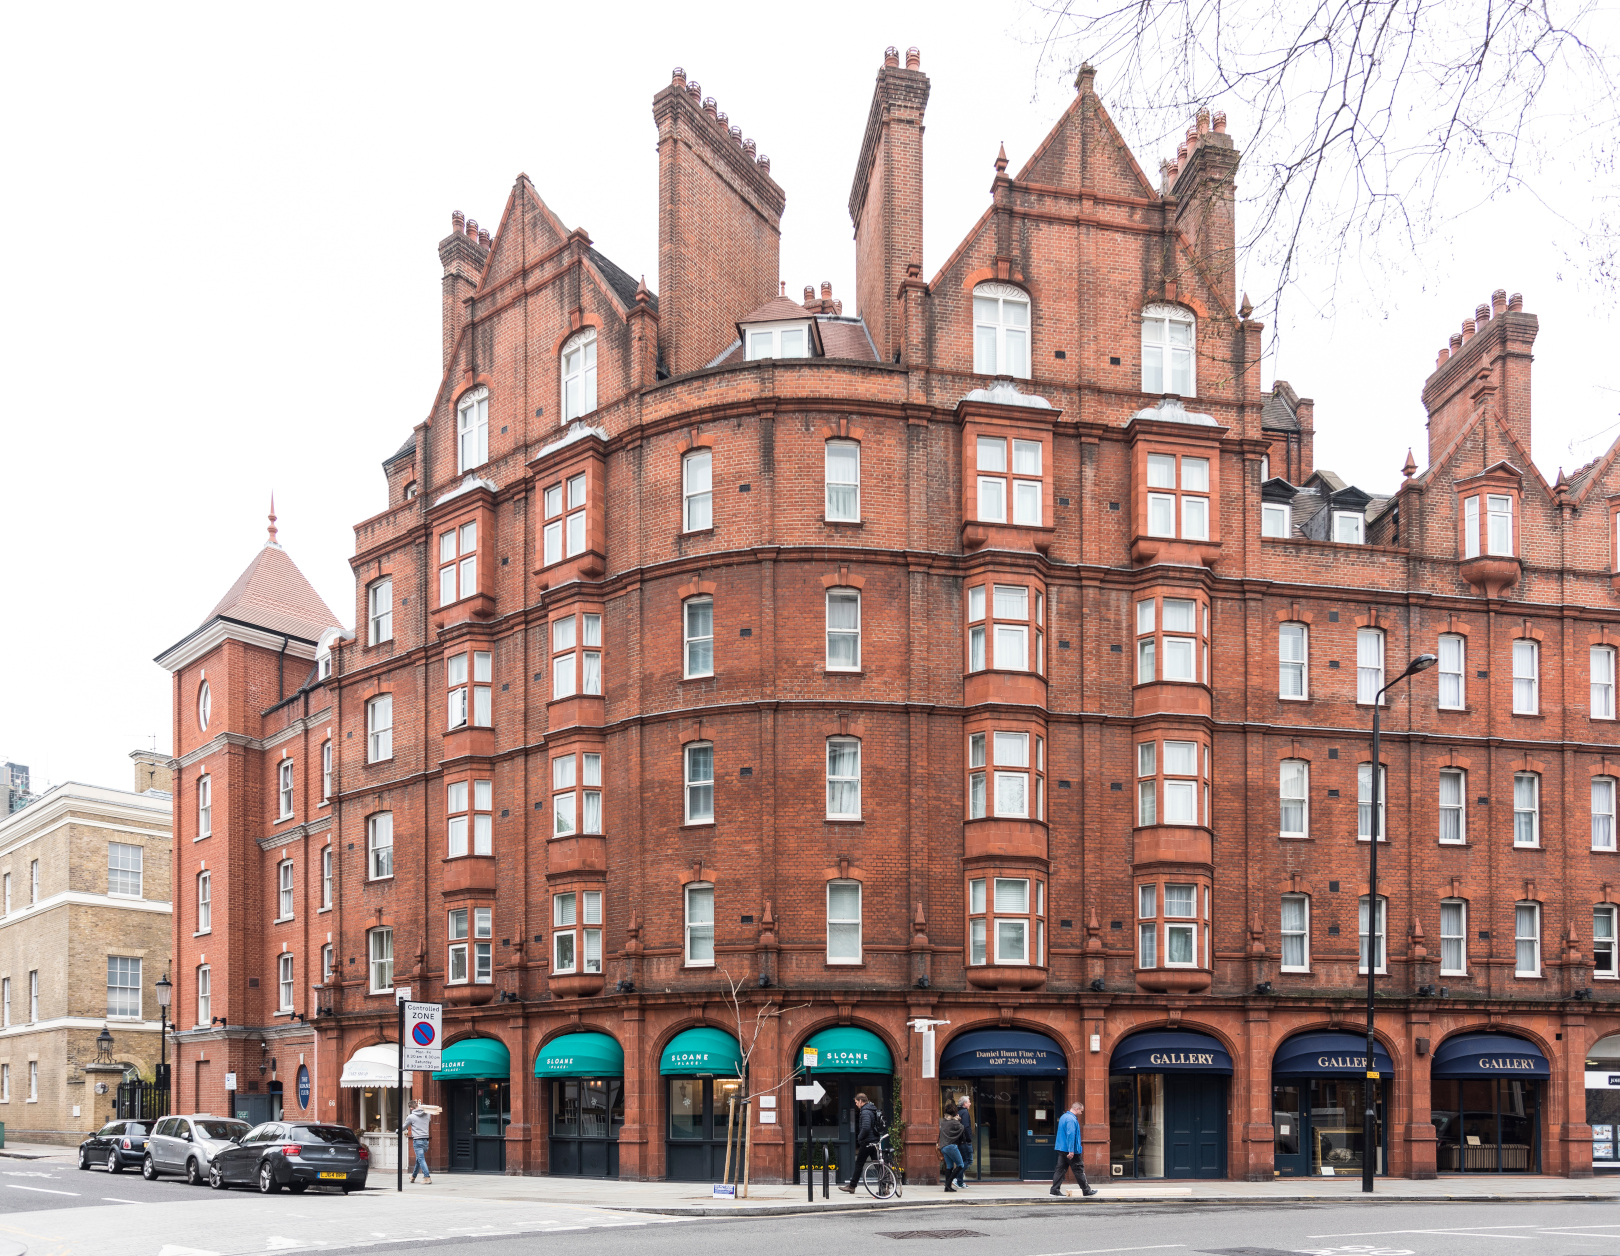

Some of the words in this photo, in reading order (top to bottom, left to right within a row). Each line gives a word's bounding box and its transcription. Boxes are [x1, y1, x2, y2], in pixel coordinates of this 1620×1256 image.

[407, 1004, 440, 1012] Controlled
[412, 1012, 435, 1020] ZONE
[827, 1052, 868, 1060] SLOANE
[976, 1050, 999, 1058] Daniel
[1150, 1053, 1214, 1064] GALLERY
[1479, 1058, 1535, 1069] GALLERY
[328, 1099, 336, 1107] 66
